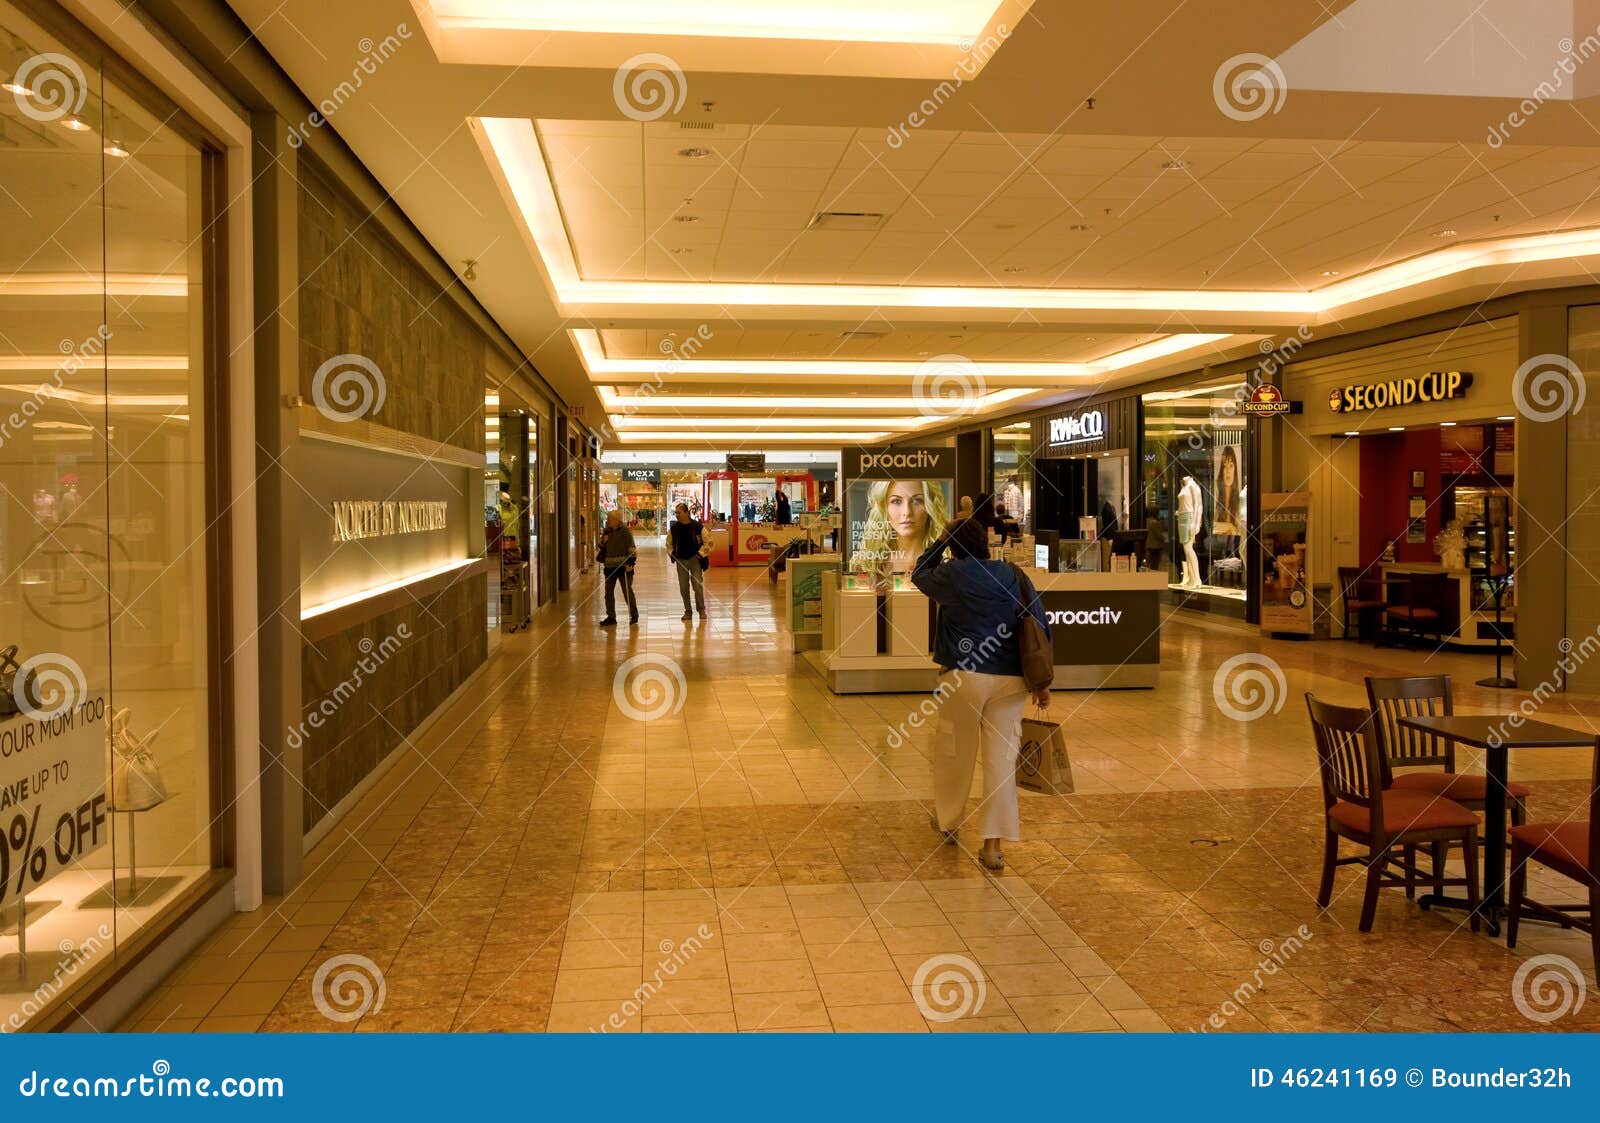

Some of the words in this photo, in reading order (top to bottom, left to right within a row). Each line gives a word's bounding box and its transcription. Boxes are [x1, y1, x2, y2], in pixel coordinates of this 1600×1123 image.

[1245, 403, 1274, 411] SECOND
[1274, 403, 1288, 411] CUP
[1344, 378, 1416, 412] SECOND
[1418, 371, 1461, 402] CUP
[860, 450, 940, 473] proactiv
[331, 500, 380, 542] NORTH
[382, 500, 395, 536] BY
[852, 521, 865, 530] I'M
[868, 520, 891, 530] NOT
[852, 540, 866, 550] I'M
[0, 723, 36, 758] OUR
[40, 708, 74, 744] MOM
[78, 697, 105, 729] TOO
[0, 778, 28, 811] AVE
[32, 768, 49, 795] UP
[53, 760, 69, 785] TO
[54, 792, 106, 866] OFF
